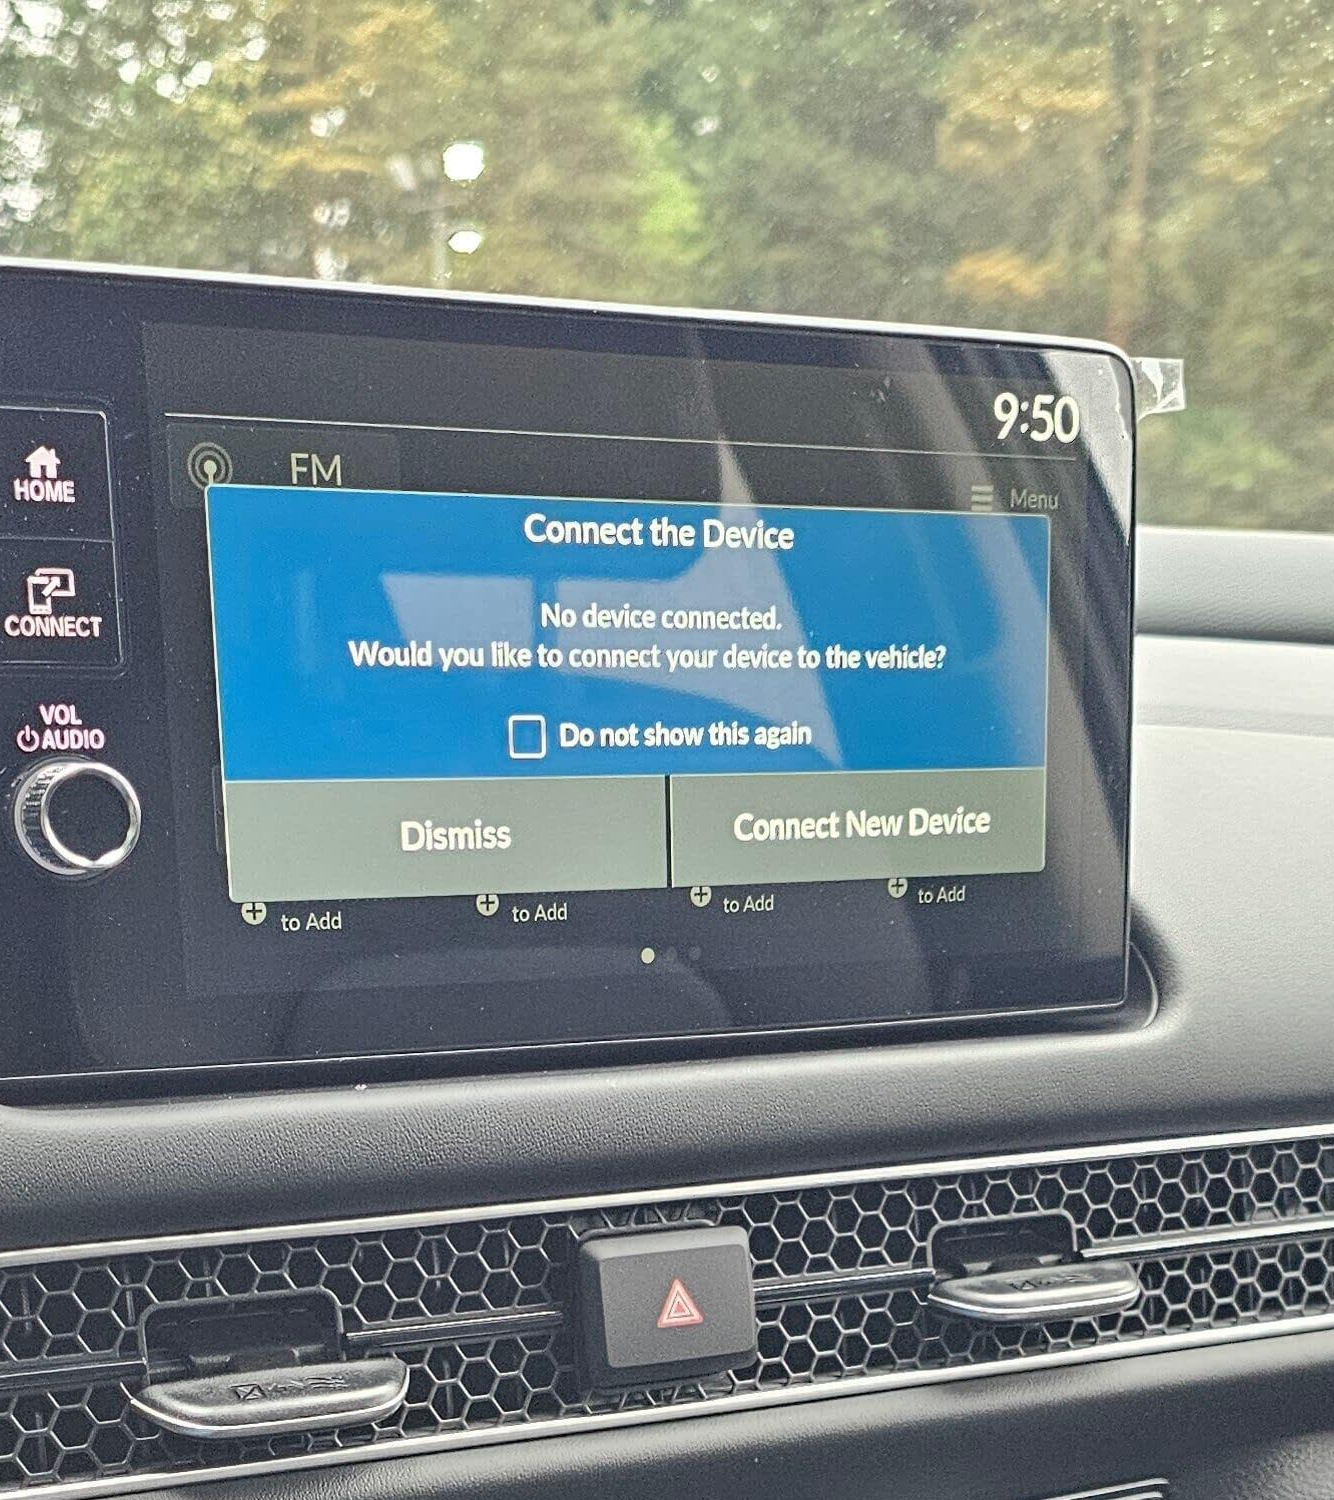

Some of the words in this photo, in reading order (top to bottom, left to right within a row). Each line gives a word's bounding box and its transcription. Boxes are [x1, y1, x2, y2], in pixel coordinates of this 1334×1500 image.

[993, 391, 1080, 444] 9:50
[289, 452, 343, 486] FM
[13, 478, 75, 503] HOME
[1009, 488, 1059, 511] Menu
[523, 512, 644, 545] Connect
[649, 517, 696, 548] the
[702, 518, 795, 550] Device
[3, 613, 103, 638] CONNECT
[540, 602, 577, 628] No
[582, 602, 656, 630] device
[661, 604, 783, 631] connected.
[347, 640, 433, 668] Would
[437, 646, 484, 672] you
[490, 641, 532, 668] like
[536, 643, 564, 668] to
[568, 643, 661, 669] connect
[667, 648, 717, 673] your
[722, 643, 792, 669] device
[796, 644, 821, 669] to
[825, 644, 862, 670] the
[865, 643, 947, 670] vehicle?
[39, 703, 83, 727] VOL
[41, 728, 105, 751] AUDIO
[559, 722, 593, 749] Do
[599, 722, 640, 748] not
[643, 721, 703, 747] show
[708, 720, 751, 746] this
[754, 720, 812, 750] again
[400, 818, 512, 852] Dismiss
[732, 810, 840, 843] Connect
[844, 808, 904, 838] New
[908, 805, 992, 836] Device
[723, 897, 740, 914] to
[743, 894, 775, 913] Add
[917, 887, 933, 904] to
[936, 885, 966, 903] Add
[280, 913, 301, 932] to
[305, 911, 343, 931] Add
[511, 904, 530, 923] to
[534, 902, 568, 922] Add
